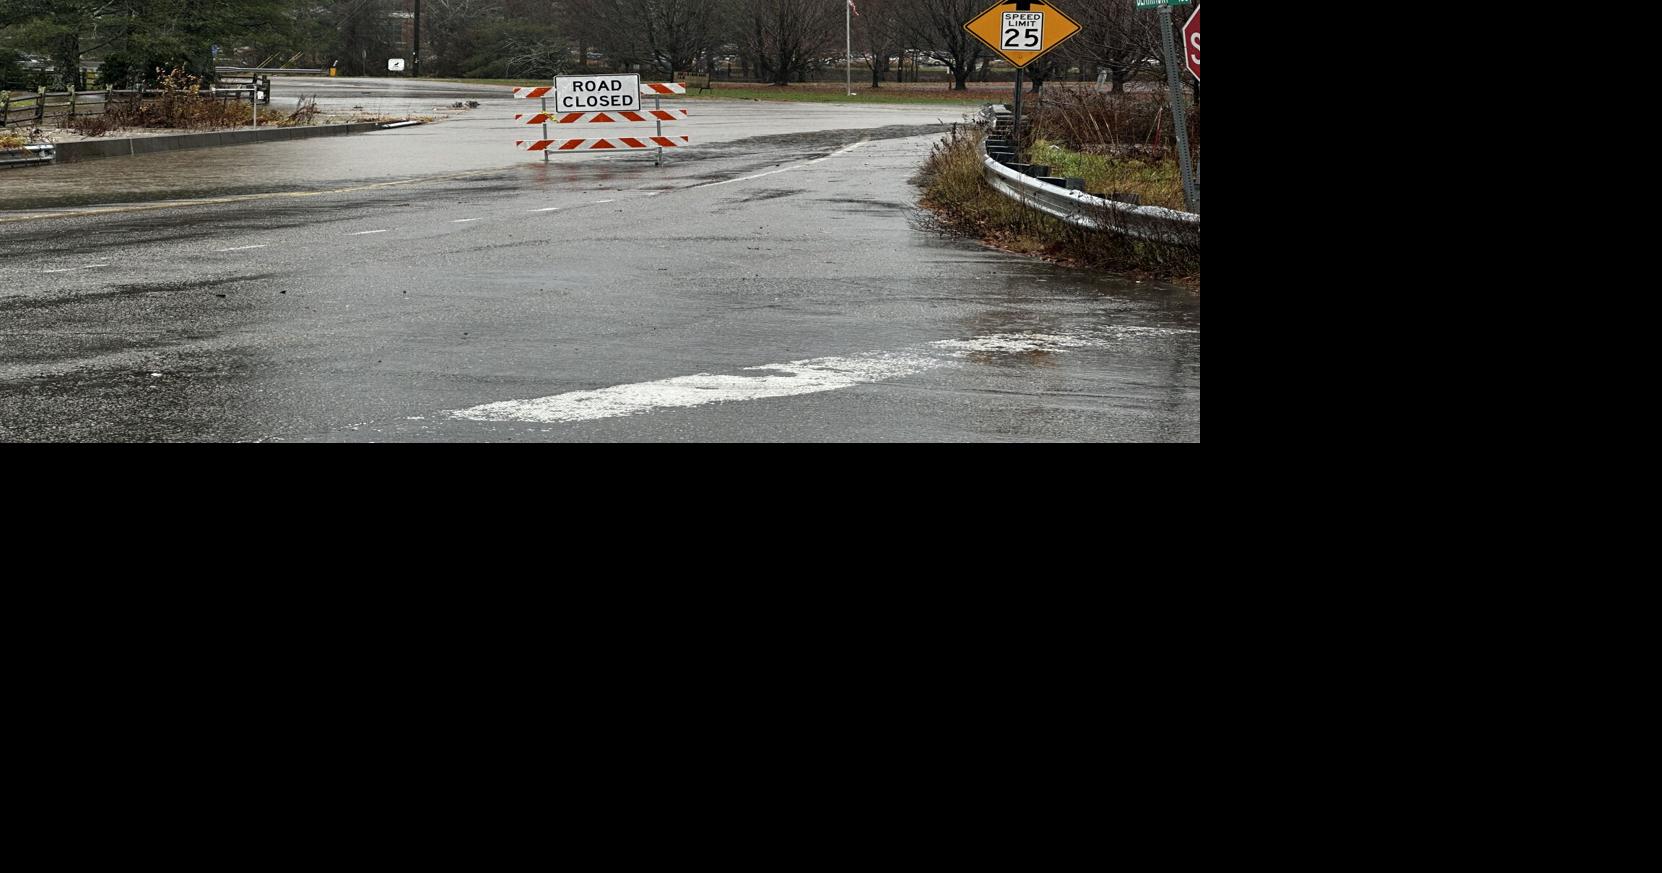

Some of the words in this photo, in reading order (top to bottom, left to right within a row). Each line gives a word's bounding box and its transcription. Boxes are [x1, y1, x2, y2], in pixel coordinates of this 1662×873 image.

[1004, 28, 1039, 47] 25
[572, 80, 622, 92] ROAD
[562, 95, 634, 108] CLOSED
